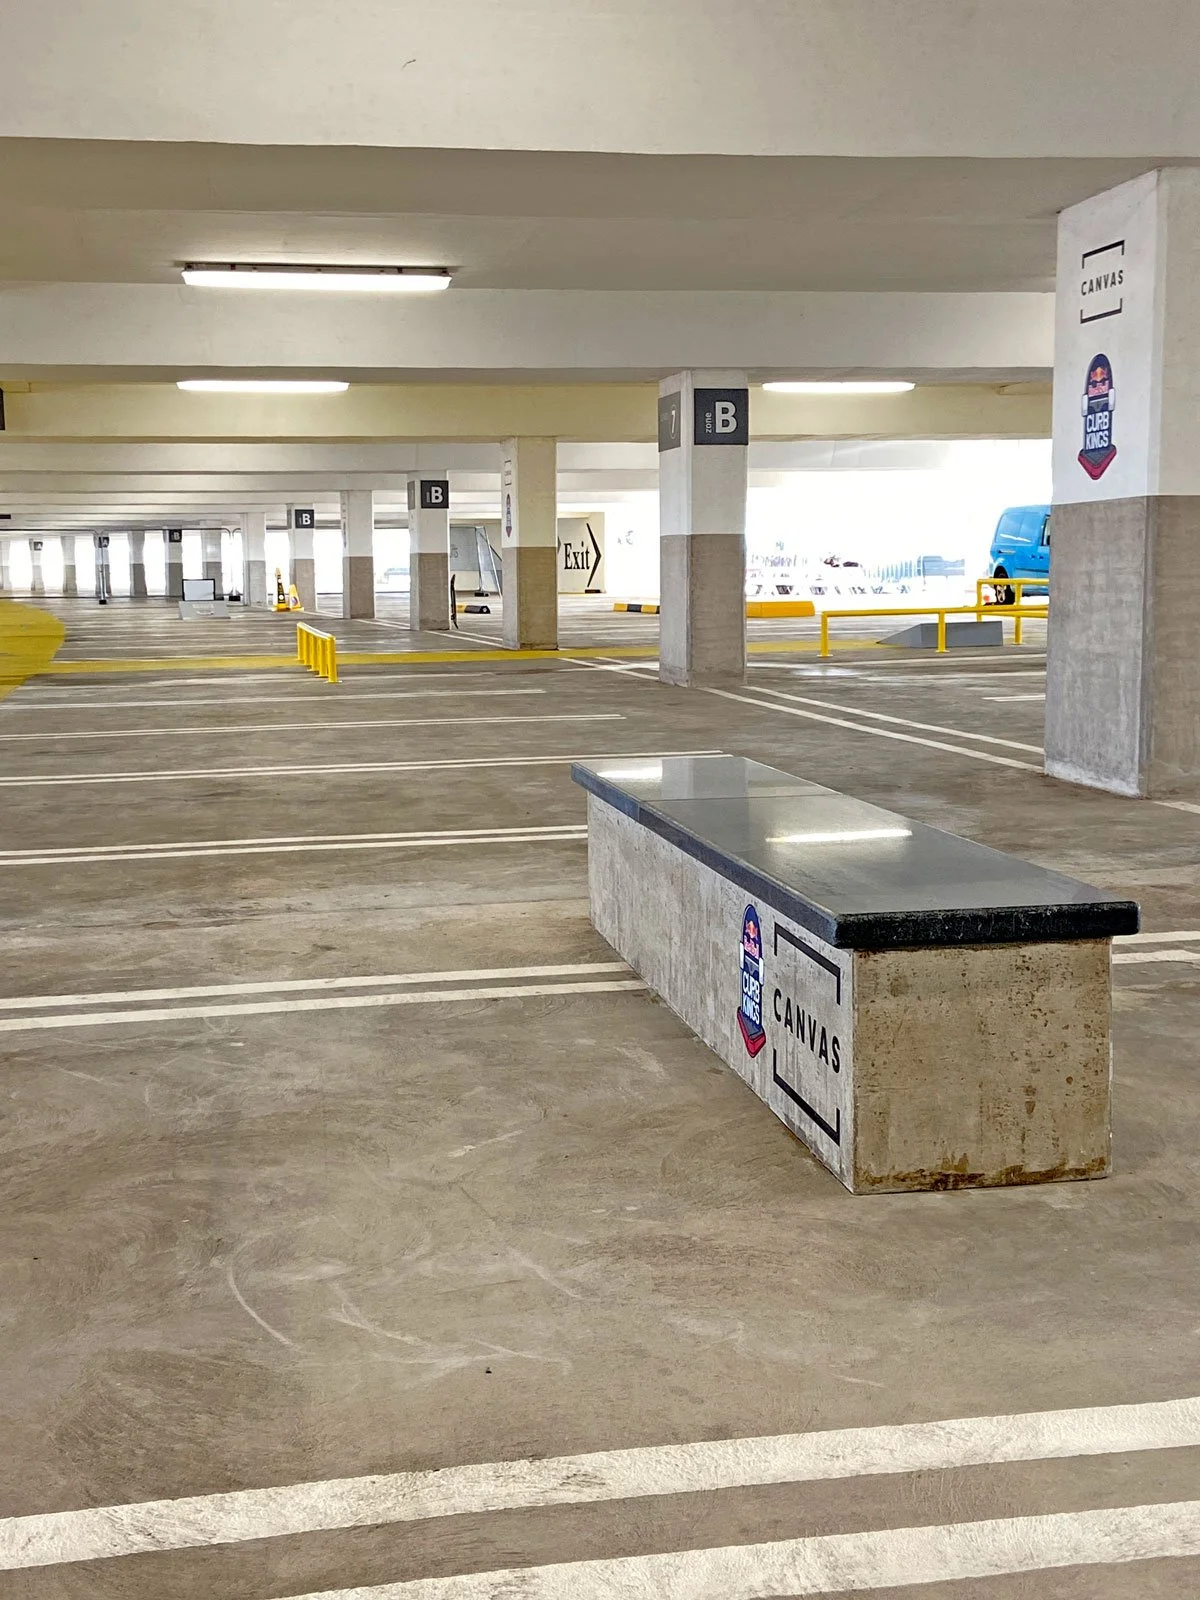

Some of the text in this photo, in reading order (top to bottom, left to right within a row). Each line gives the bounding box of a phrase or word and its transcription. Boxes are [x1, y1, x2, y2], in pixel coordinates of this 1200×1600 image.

[1081, 269, 1124, 296] CANVAS
[705, 401, 737, 434] zone B
[1086, 411, 1110, 433] CURB
[1086, 431, 1109, 450] KINGS
[431, 486, 443, 503] B
[302, 513, 311, 525] B
[564, 541, 590, 570] Exit
[743, 970, 760, 1004] CURB
[773, 988, 840, 1073] CANVAS
